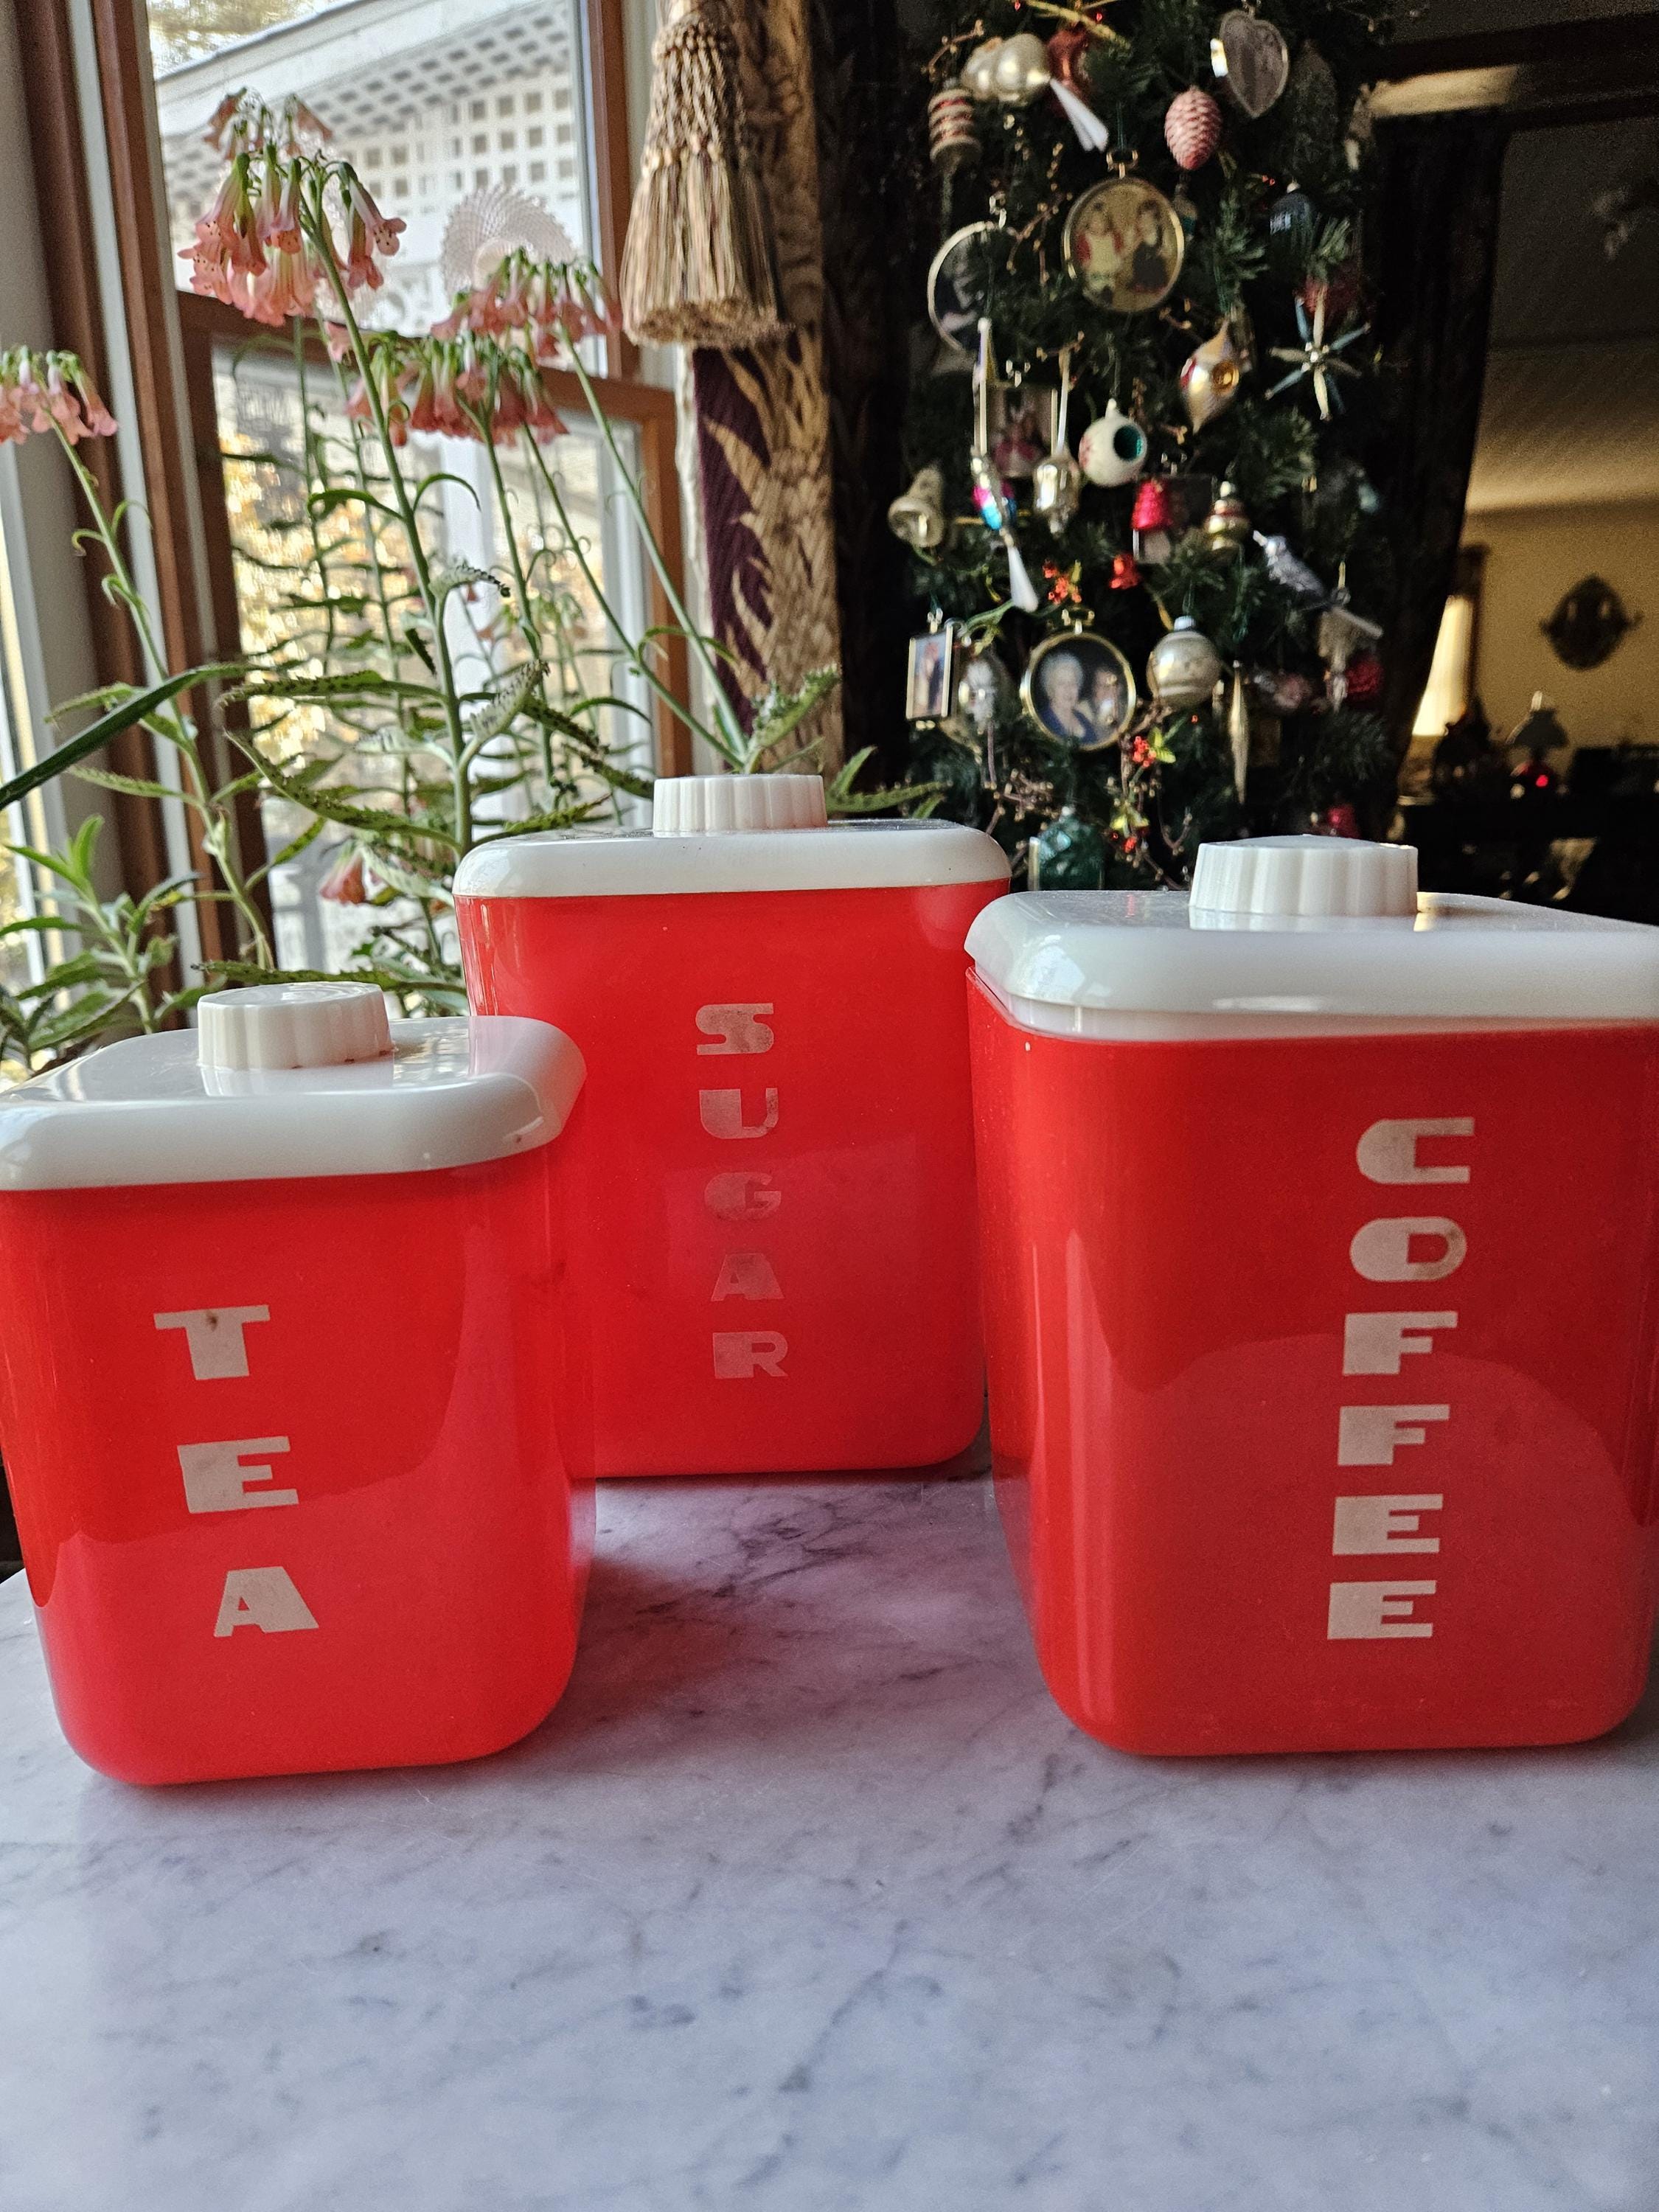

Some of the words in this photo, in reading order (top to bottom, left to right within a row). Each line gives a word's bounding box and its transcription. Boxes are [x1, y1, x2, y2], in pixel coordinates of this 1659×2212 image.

[695, 1002, 789, 1380] SUGAR
[1326, 1116, 1475, 1641] COFFEE
[153, 1304, 320, 1638] TEA
